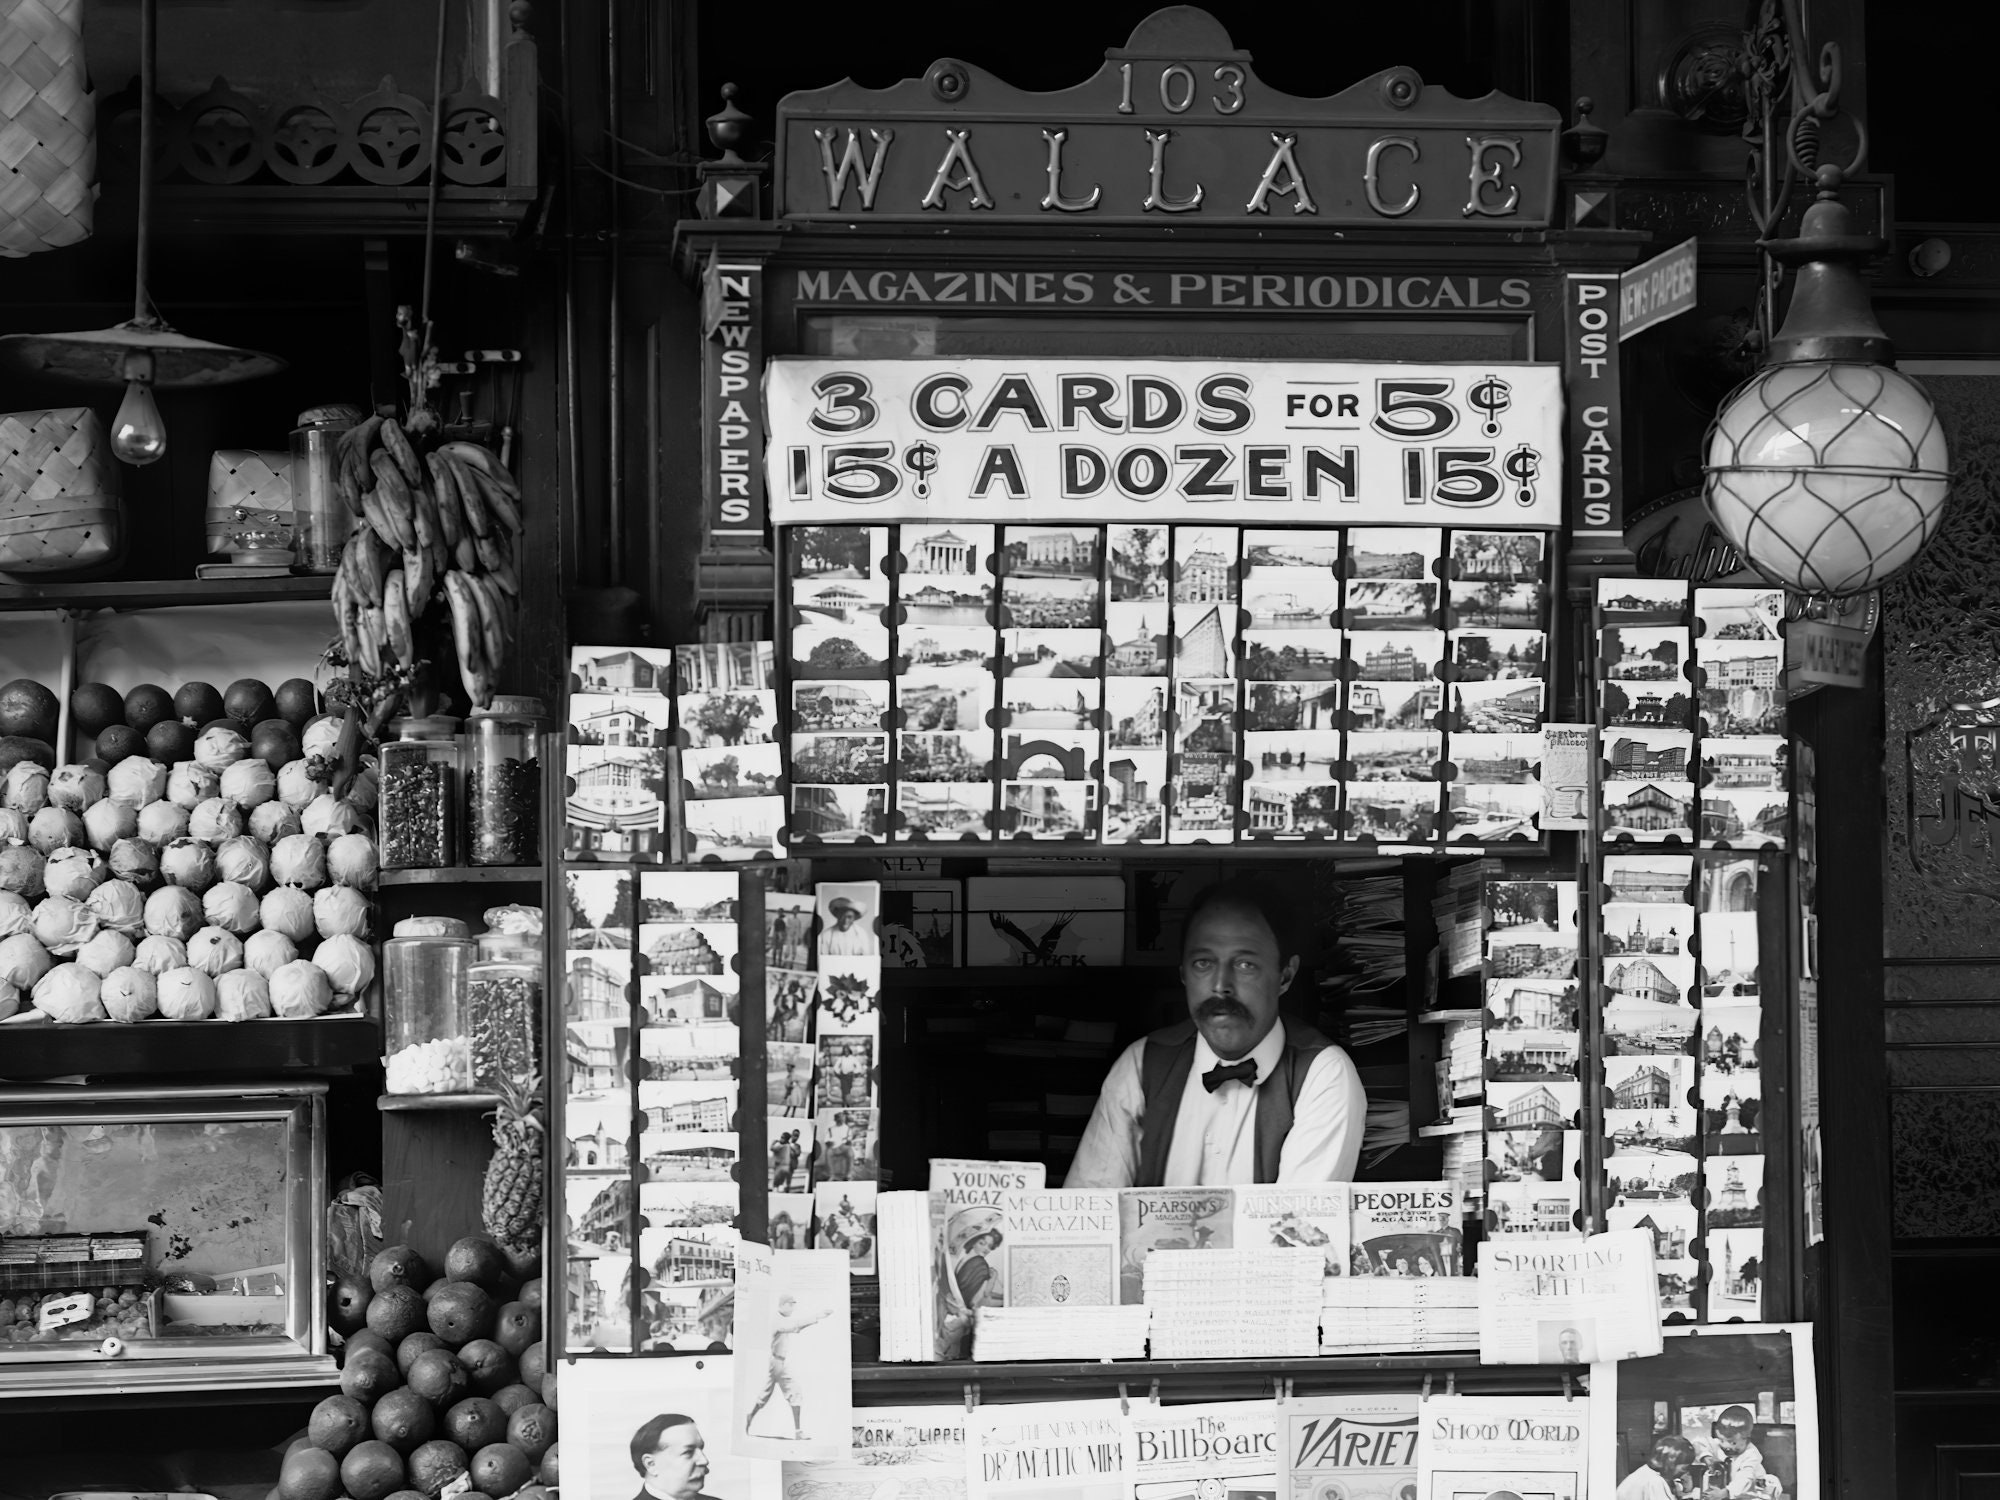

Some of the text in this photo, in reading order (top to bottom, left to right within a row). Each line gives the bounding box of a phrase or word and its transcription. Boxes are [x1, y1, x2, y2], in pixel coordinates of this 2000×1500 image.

[1116, 62, 1246, 115] 103
[813, 127, 1522, 218] WALLACE
[797, 270, 1532, 309] MAGAZINES & PERIODICALS
[718, 276, 752, 523] NEWSPAPERS
[806, 371, 880, 437] 3
[909, 372, 1256, 436] CARDS
[1286, 394, 1360, 418] FOR
[1578, 284, 1612, 525] POST CARDS
[968, 443, 1031, 500] A
[1059, 443, 1360, 503] DOZEN
[952, 1172, 1026, 1189] YOUNG'S
[1354, 1192, 1453, 1210] PEOPLE'S
[1008, 1216, 1113, 1232] MAGAZINE
[1494, 1248, 1623, 1272] SPORTING
[1196, 1416, 1227, 1439] The
[1432, 1417, 1580, 1442] SHOW WORLD
[983, 1446, 1082, 1482] DRAMATIC
